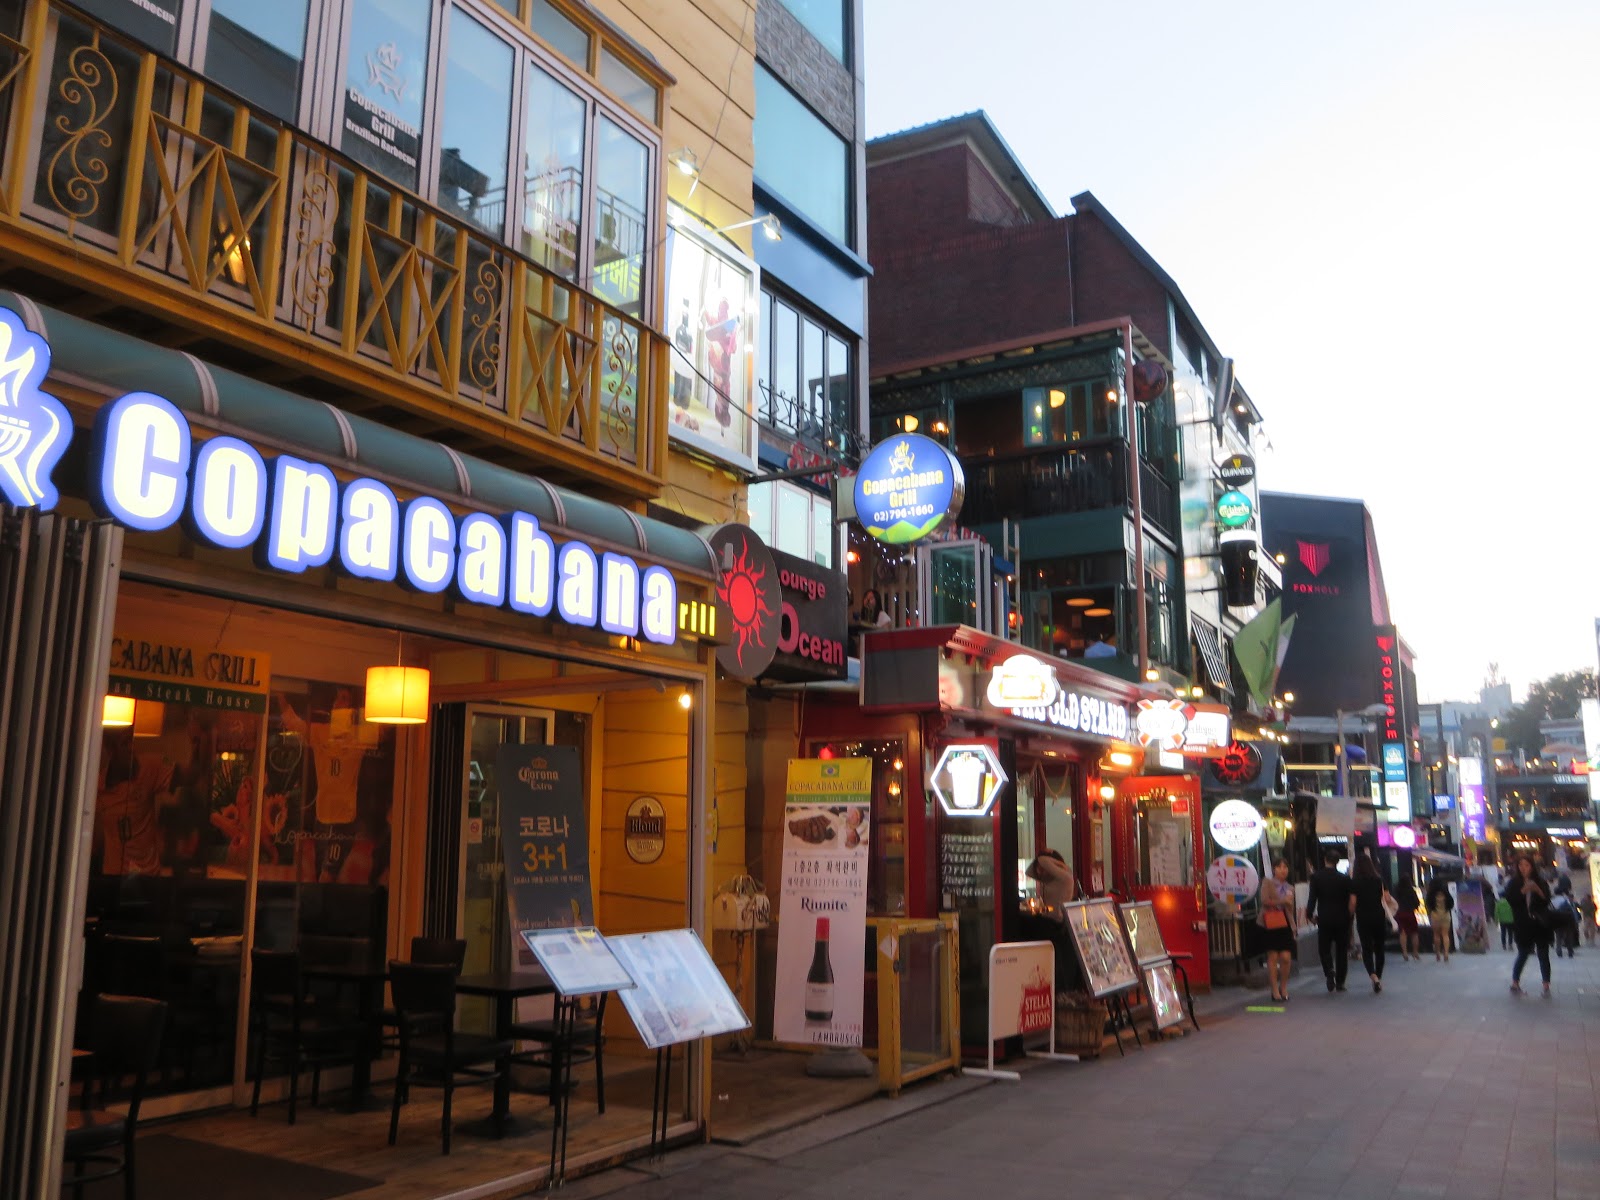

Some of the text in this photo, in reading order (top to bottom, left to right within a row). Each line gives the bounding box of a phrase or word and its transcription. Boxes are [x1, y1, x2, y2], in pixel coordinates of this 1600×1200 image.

[349, 86, 419, 140] Copacabana
[371, 115, 396, 142] Grill
[345, 117, 417, 168] Brazilian Barbecue
[863, 469, 944, 496] Copacabana
[1221, 467, 1254, 477] GUINNESS
[889, 488, 917, 508] Grill
[106, 395, 717, 642] Copacabana rill
[780, 569, 827, 601] ounge
[1292, 583, 1340, 596] FOXHOLE
[777, 601, 844, 666] Ocean
[109, 638, 261, 687] CABANA GRILL
[147, 682, 192, 703] Steak
[206, 690, 251, 709] House
[1381, 655, 1398, 740] FOXHOLE
[1079, 694, 1128, 739] STAND
[518, 766, 560, 782] Corona
[530, 780, 553, 791] Extra
[519, 815, 570, 838] 코로나
[522, 842, 568, 873] 3+1
[801, 896, 849, 914] Riunite
[1024, 995, 1052, 1012] STELLA
[1024, 1010, 1052, 1029] ARTOIS
